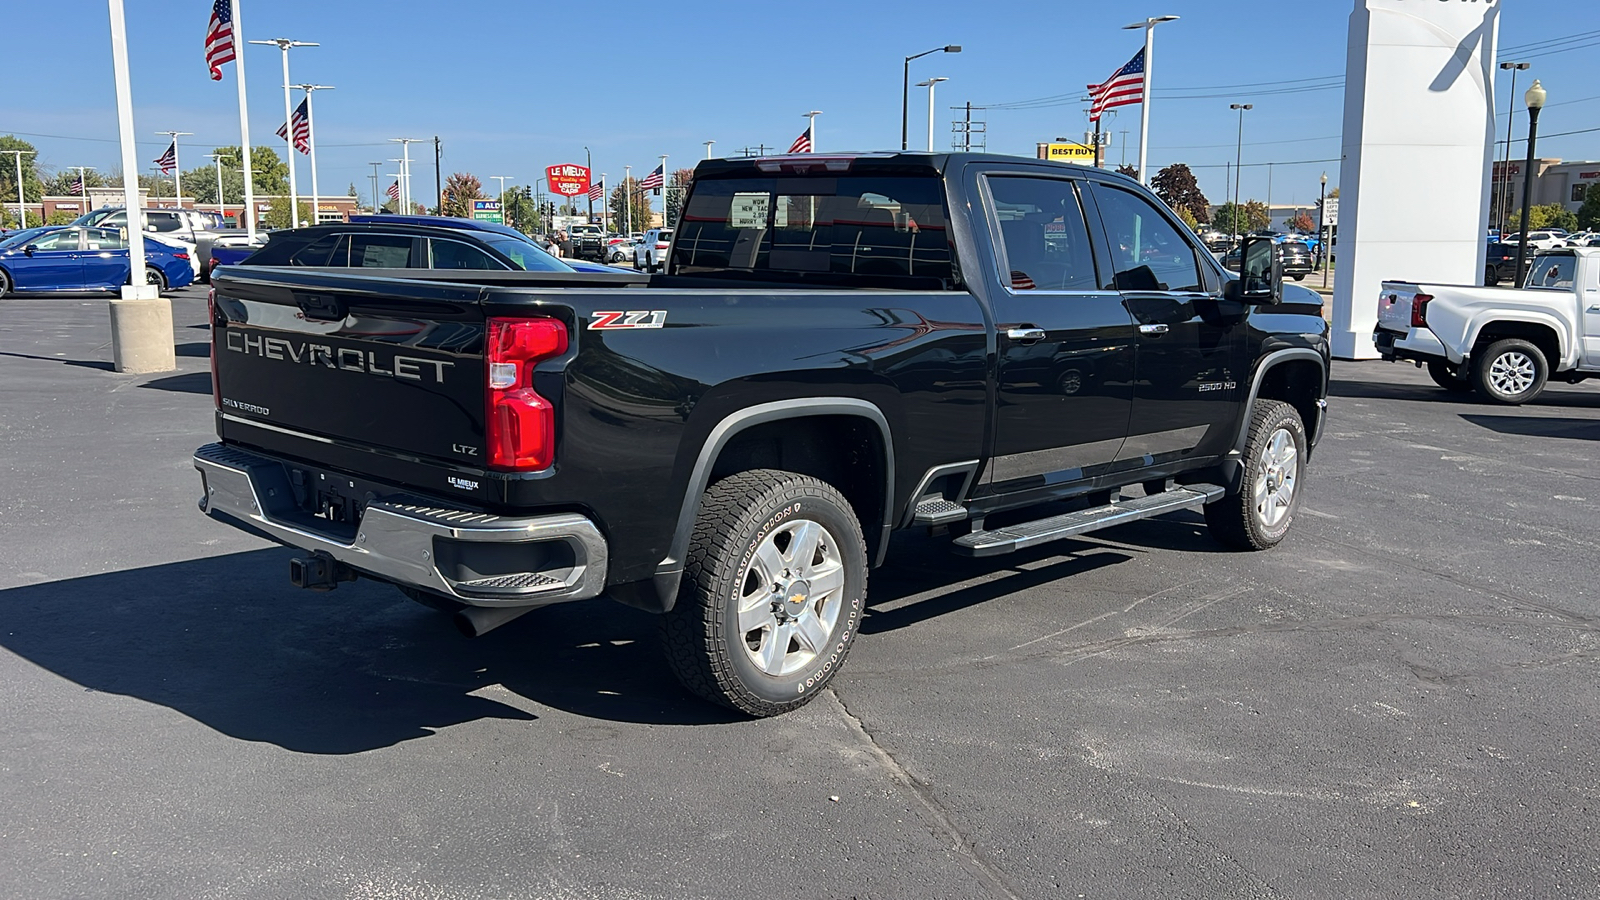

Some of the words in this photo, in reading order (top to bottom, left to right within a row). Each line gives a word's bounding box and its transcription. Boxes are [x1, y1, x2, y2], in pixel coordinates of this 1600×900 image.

[551, 167, 560, 176] LE
[562, 166, 586, 177] MIEUX
[587, 310, 667, 330] Z71
[226, 331, 455, 384] CHEVROLET
[1199, 382, 1222, 392] 2500
[1224, 381, 1236, 390] HD
[223, 397, 270, 416] SILVERADO
[452, 443, 478, 456] LTZ
[447, 476, 456, 484] LE
[457, 478, 479, 489] MIEUX
